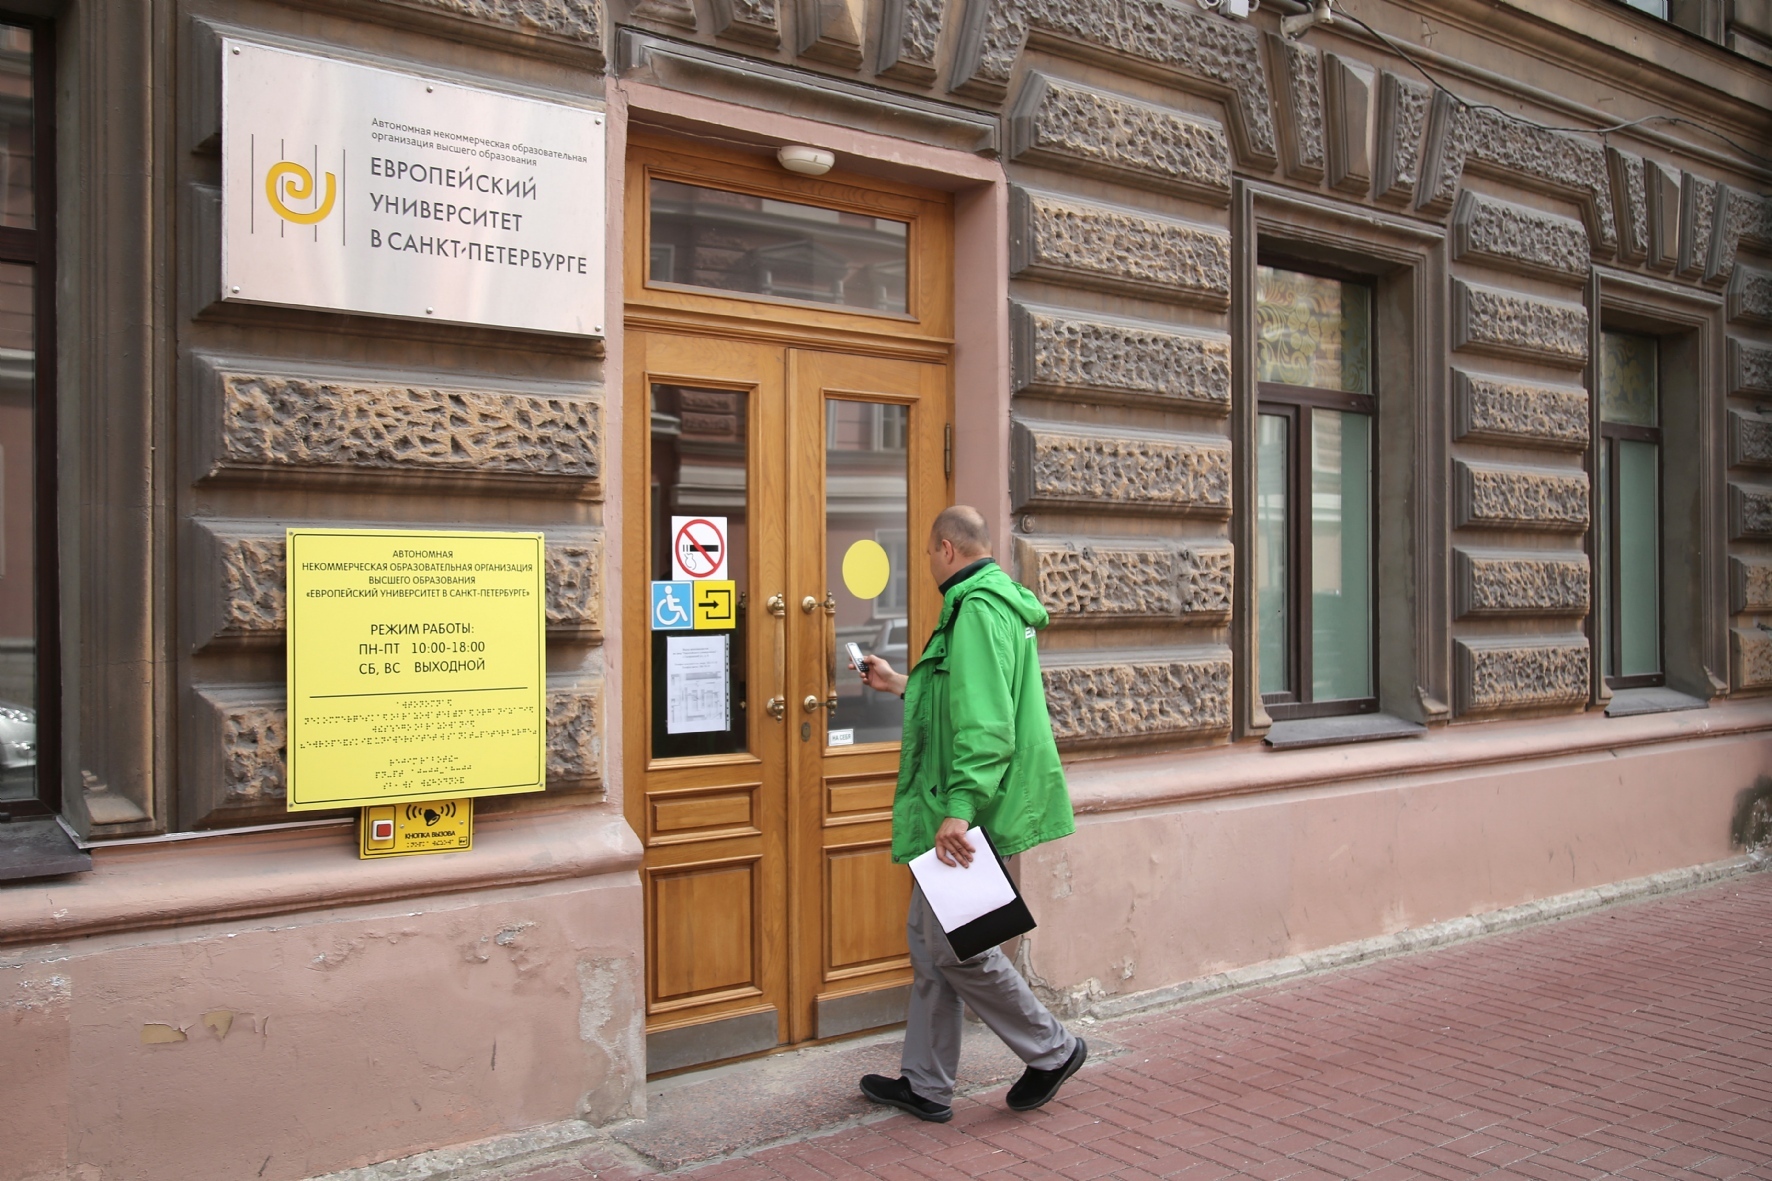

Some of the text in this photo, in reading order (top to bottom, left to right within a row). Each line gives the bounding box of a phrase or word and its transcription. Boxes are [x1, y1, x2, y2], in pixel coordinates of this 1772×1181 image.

[371, 117, 588, 163] Автономная некоммерческая образовательная
[371, 132, 537, 167] организация высшего образования
[371, 156, 537, 201] ЕВРОПЕЙСКИЙ
[370, 192, 523, 233] УНИВЕРСИТЕТ
[371, 228, 587, 275] В САНКТ-ПЕТЕРБУРГЕ
[392, 550, 453, 559] АВТОНОМНАЯ
[302, 562, 533, 573] НЕКОММЕРЧЕСКАЯ ОБРАЗОВАТЕЛЬНАЯ ОРГАНИЗАЦИЯ
[368, 576, 476, 585] ВЫСШЕГО ОБРАЗОВАНИЯ
[306, 588, 530, 598] «ЕВРОПЕЙСКИЙ УНИВЕРСИТЕТ В САНКТ-ПЕТЕРБУРГЕ»
[370, 622, 475, 635] РЕЖИМ РАБОТЫ:
[359, 641, 486, 655] ПН-ПТ 10:00-18:00
[359, 658, 485, 676] СБ, ВС ВЫХОДНОЙ
[405, 830, 456, 839] КНОПКА ВЫЗОВА
